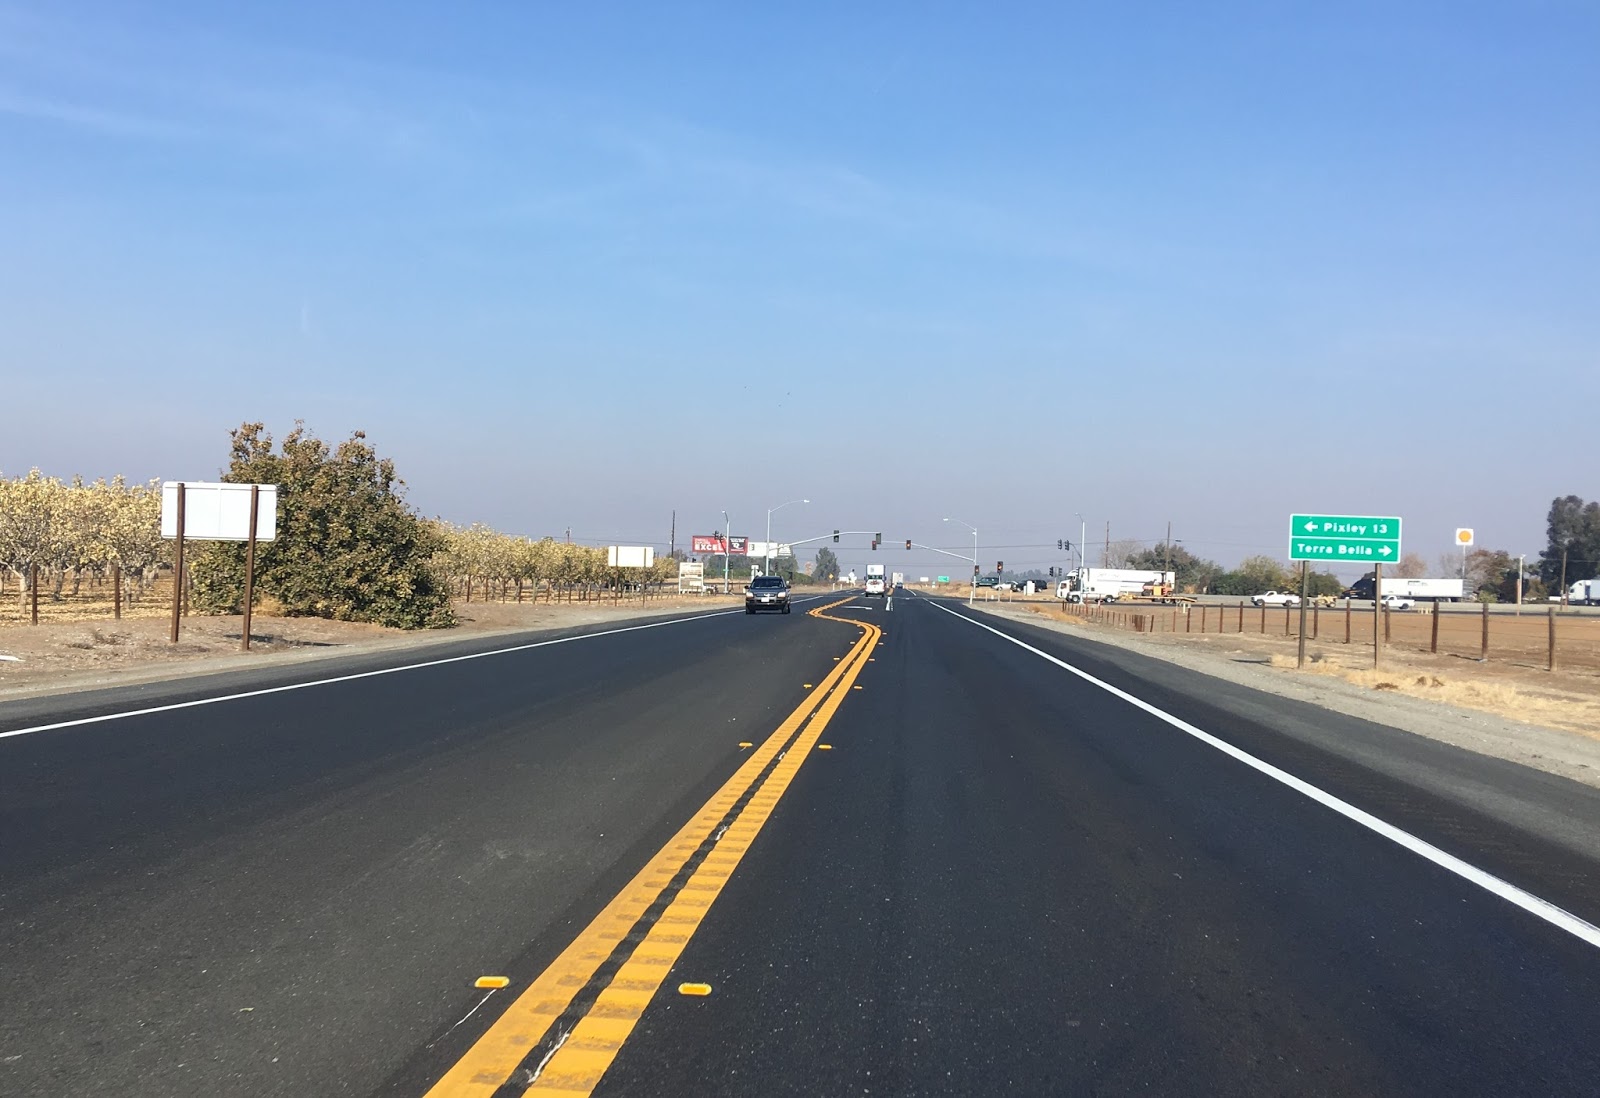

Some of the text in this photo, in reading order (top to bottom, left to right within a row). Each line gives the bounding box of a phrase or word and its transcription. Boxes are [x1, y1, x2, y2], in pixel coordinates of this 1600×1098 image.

[1324, 522, 1388, 535] Pixley 13
[1297, 543, 1373, 555] Terra Bella
